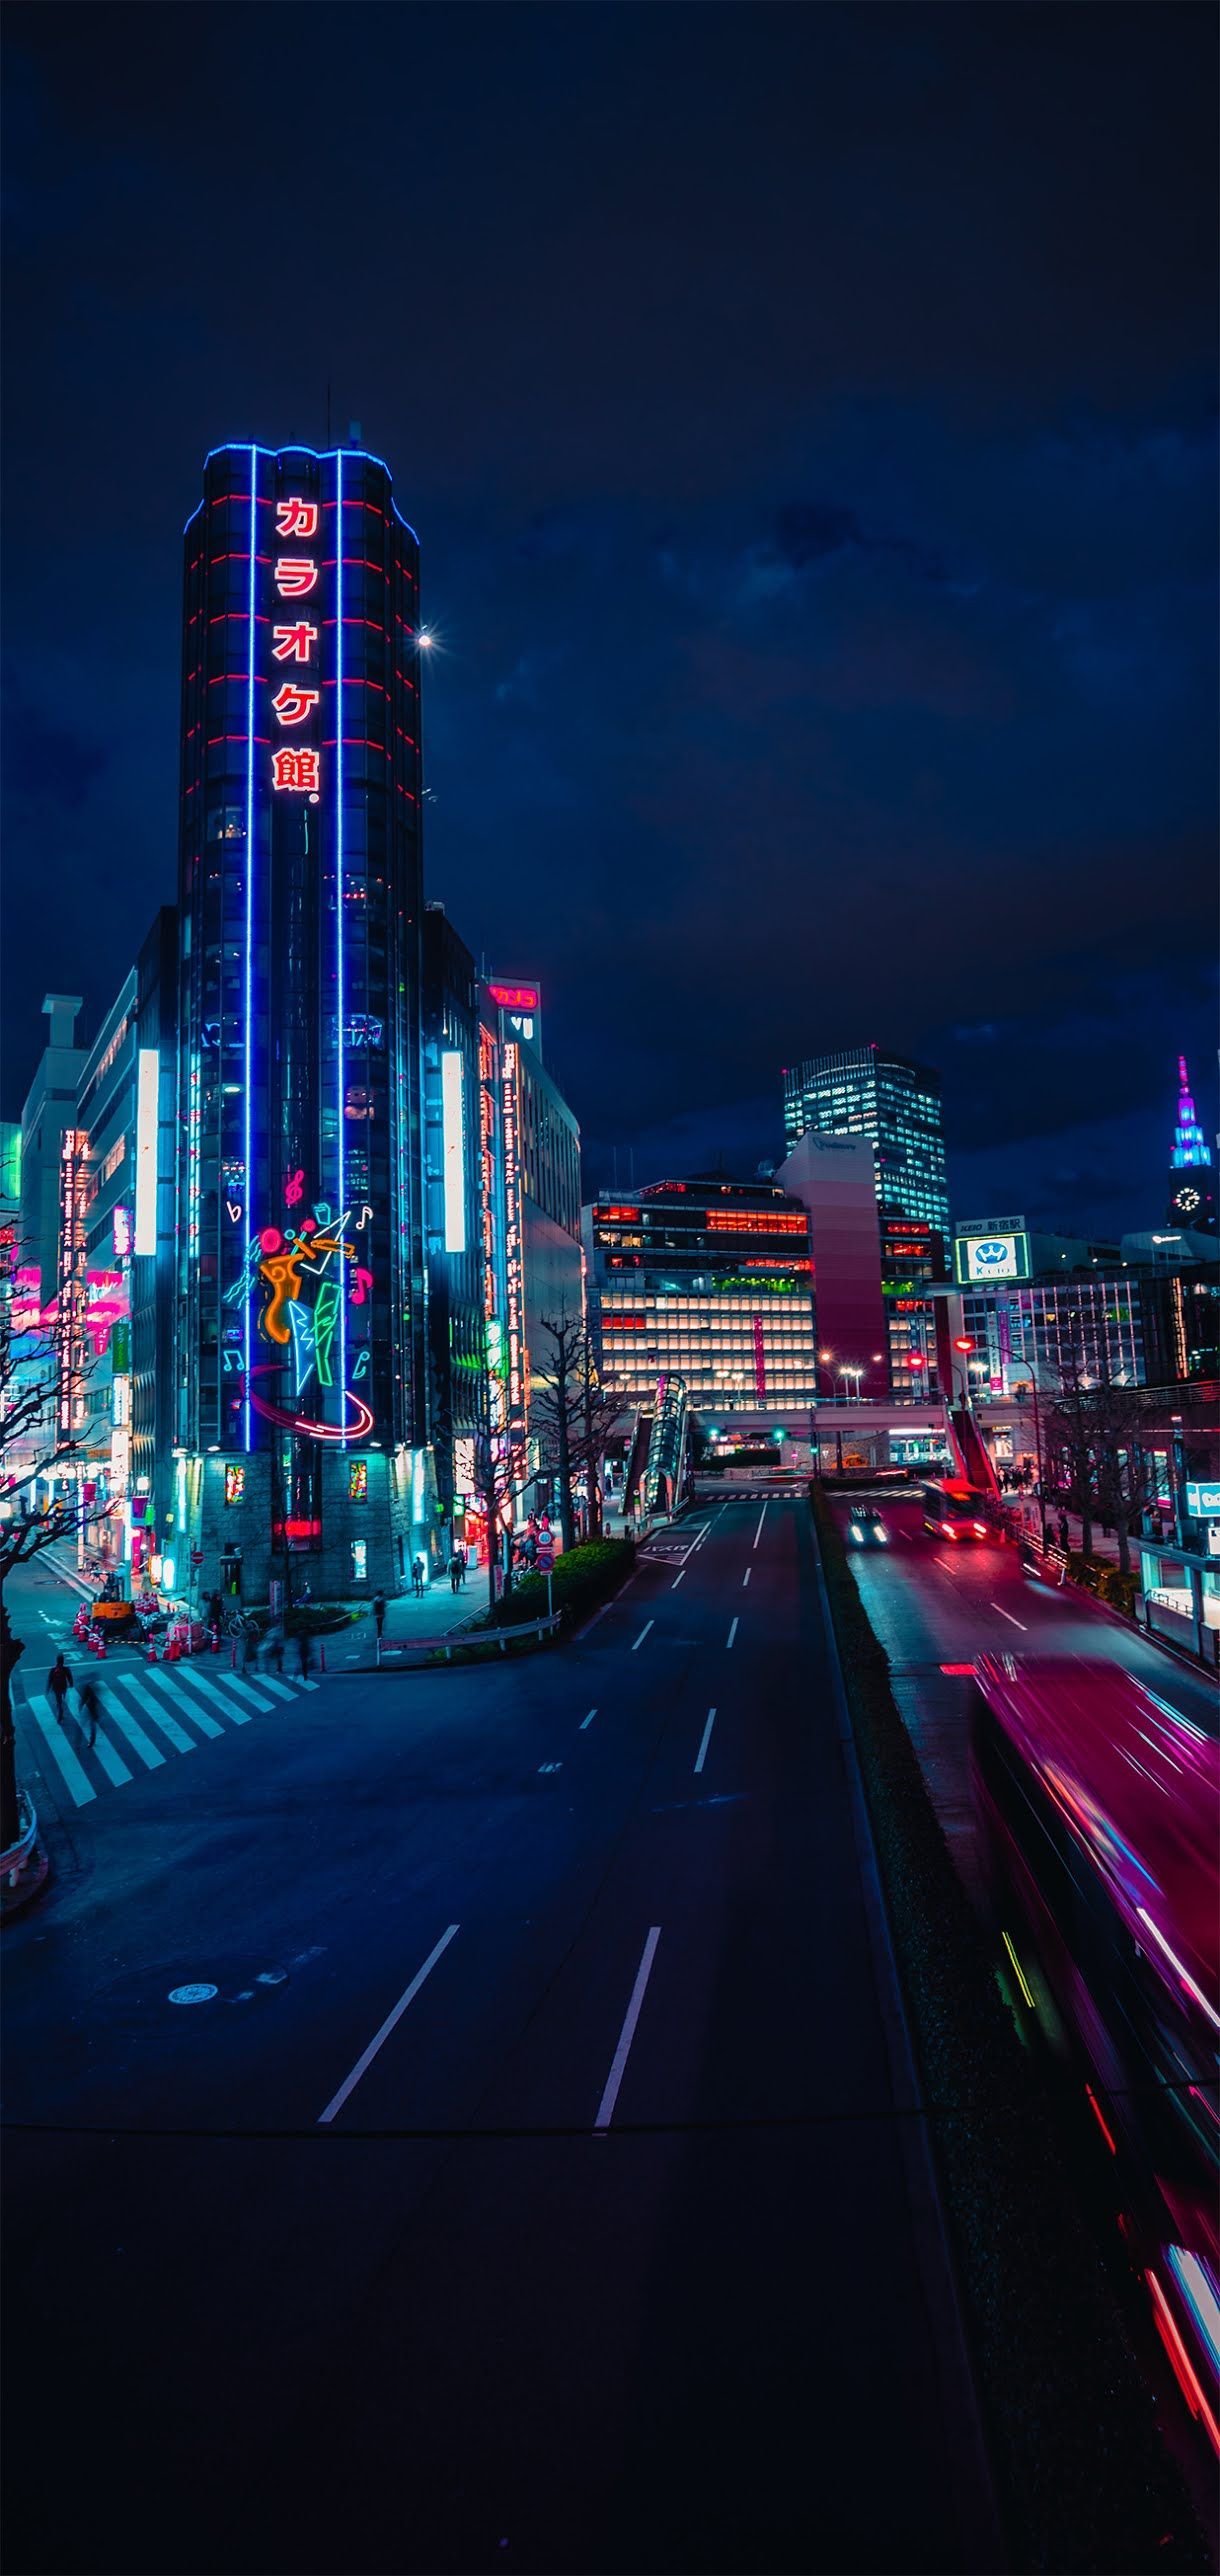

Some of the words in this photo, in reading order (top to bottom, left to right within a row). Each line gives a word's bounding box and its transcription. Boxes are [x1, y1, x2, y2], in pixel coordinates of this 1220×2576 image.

[272, 497, 320, 791] カラオケ館
[960, 1223, 983, 1233] KEIO
[987, 1218, 1021, 1232] 新宿駅
